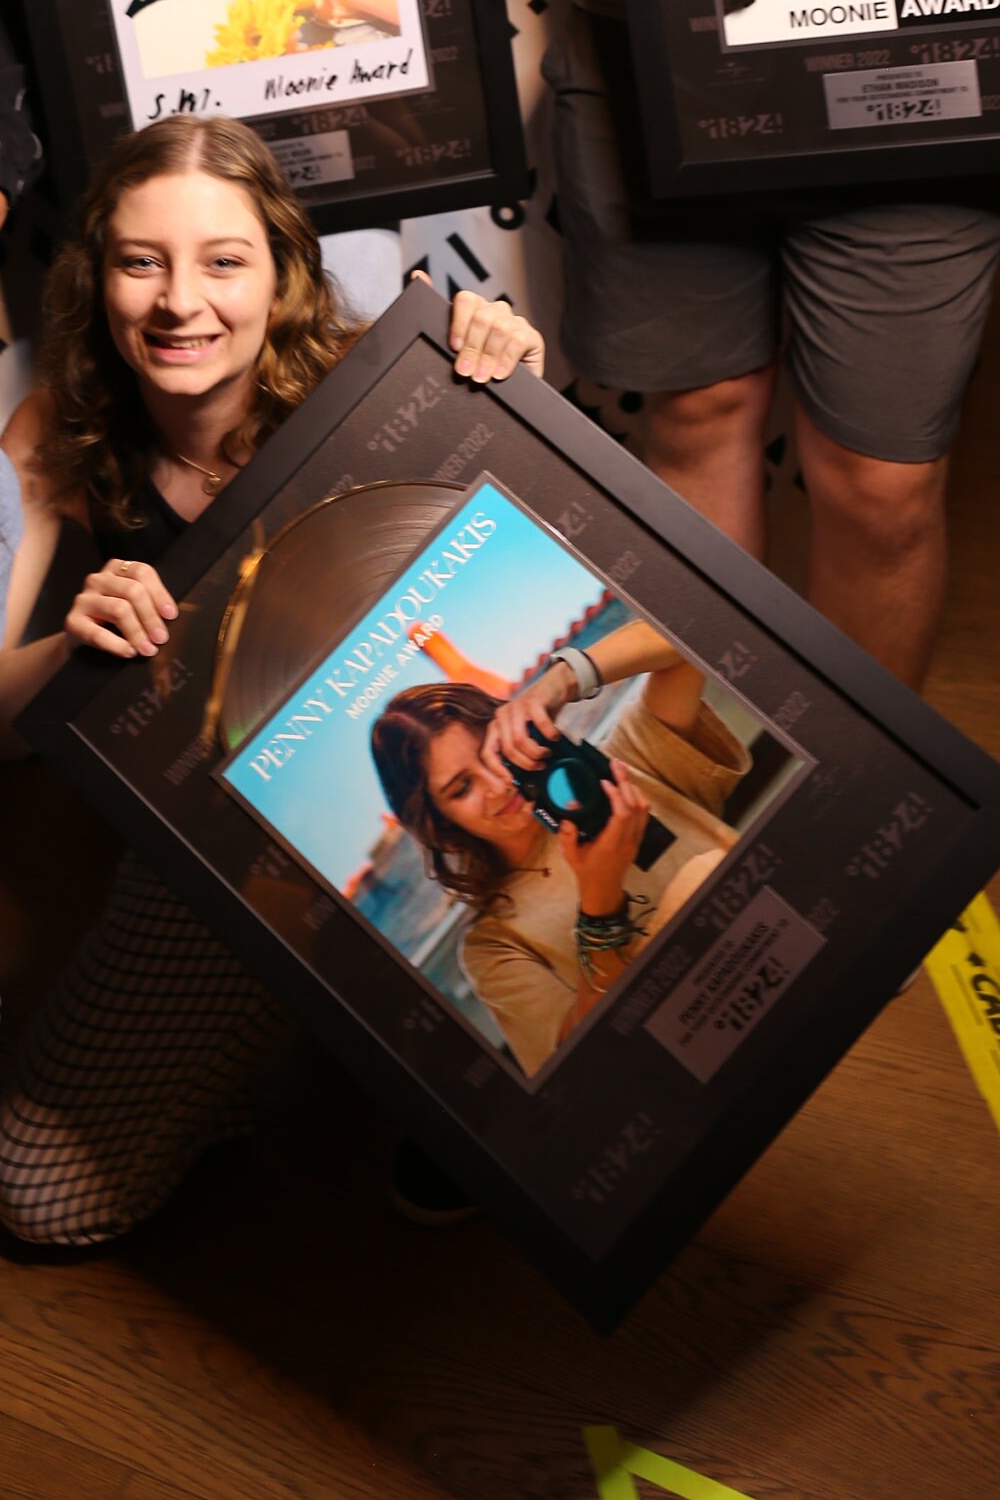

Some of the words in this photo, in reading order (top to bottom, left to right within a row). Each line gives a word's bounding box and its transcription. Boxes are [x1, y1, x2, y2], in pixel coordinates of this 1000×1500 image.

[789, 1, 889, 29] MOONIE
[862, 82, 893, 94] ETHAN
[895, 78, 939, 91] MADISON
[249, 688, 334, 783] PENNY
[324, 511, 498, 698] KAPADOUKAKIS
[346, 664, 400, 721] MOONIE
[395, 613, 446, 667] AWARD
